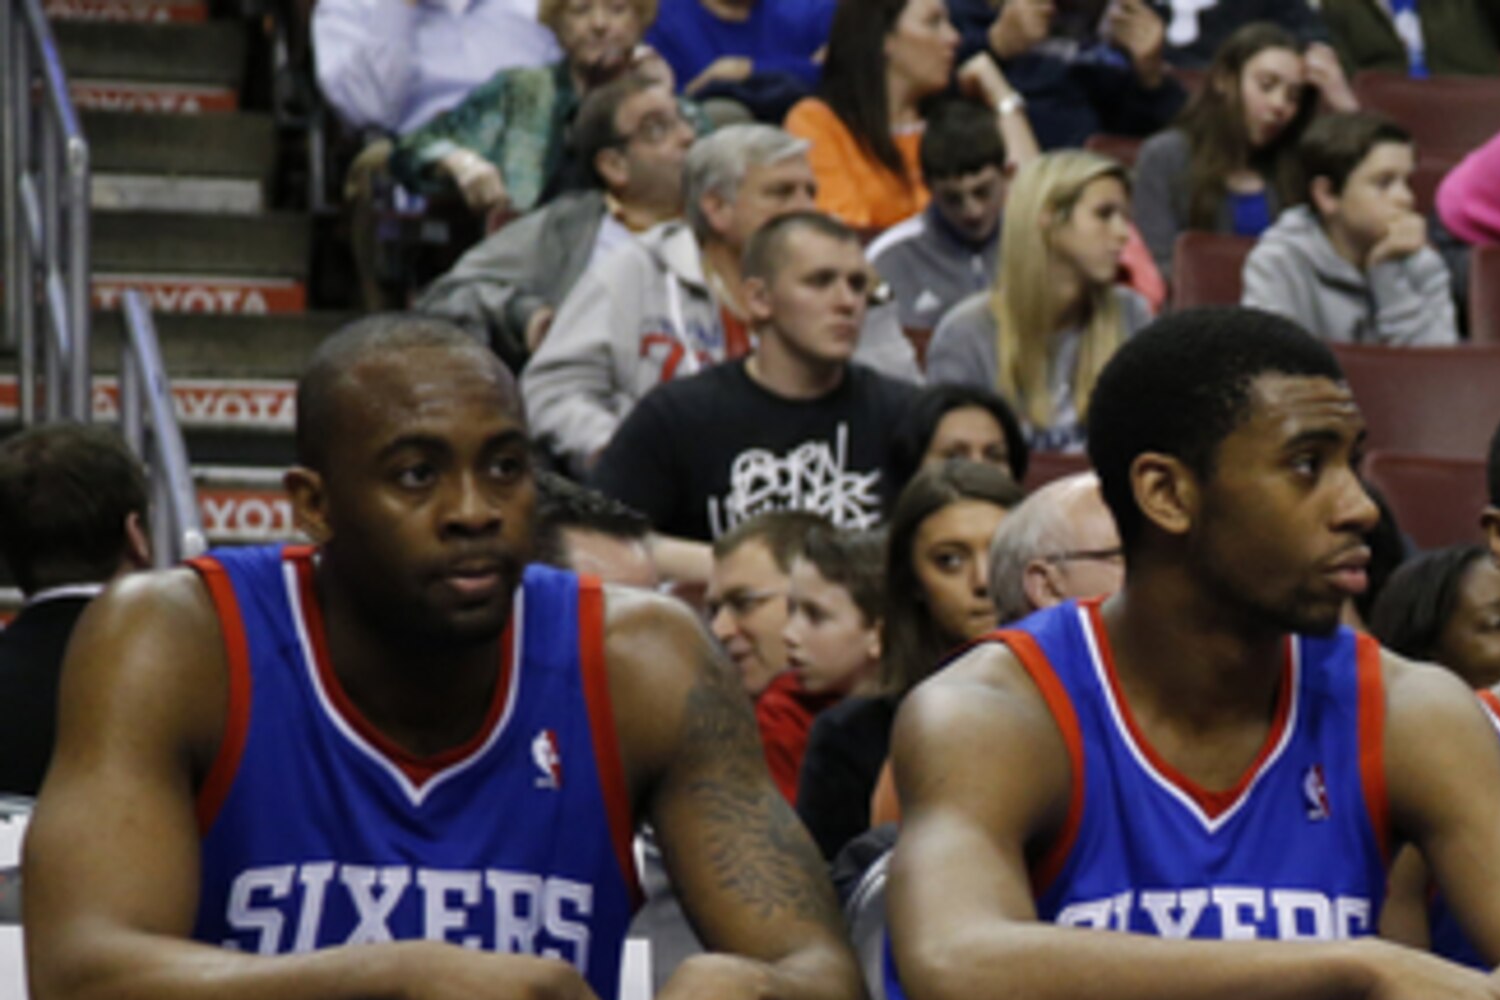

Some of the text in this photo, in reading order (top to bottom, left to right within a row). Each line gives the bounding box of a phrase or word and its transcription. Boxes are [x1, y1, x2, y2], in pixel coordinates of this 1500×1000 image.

[94, 287, 268, 315] TYOTA
[203, 498, 294, 535] YOT
[222, 861, 595, 975] SIXERS
